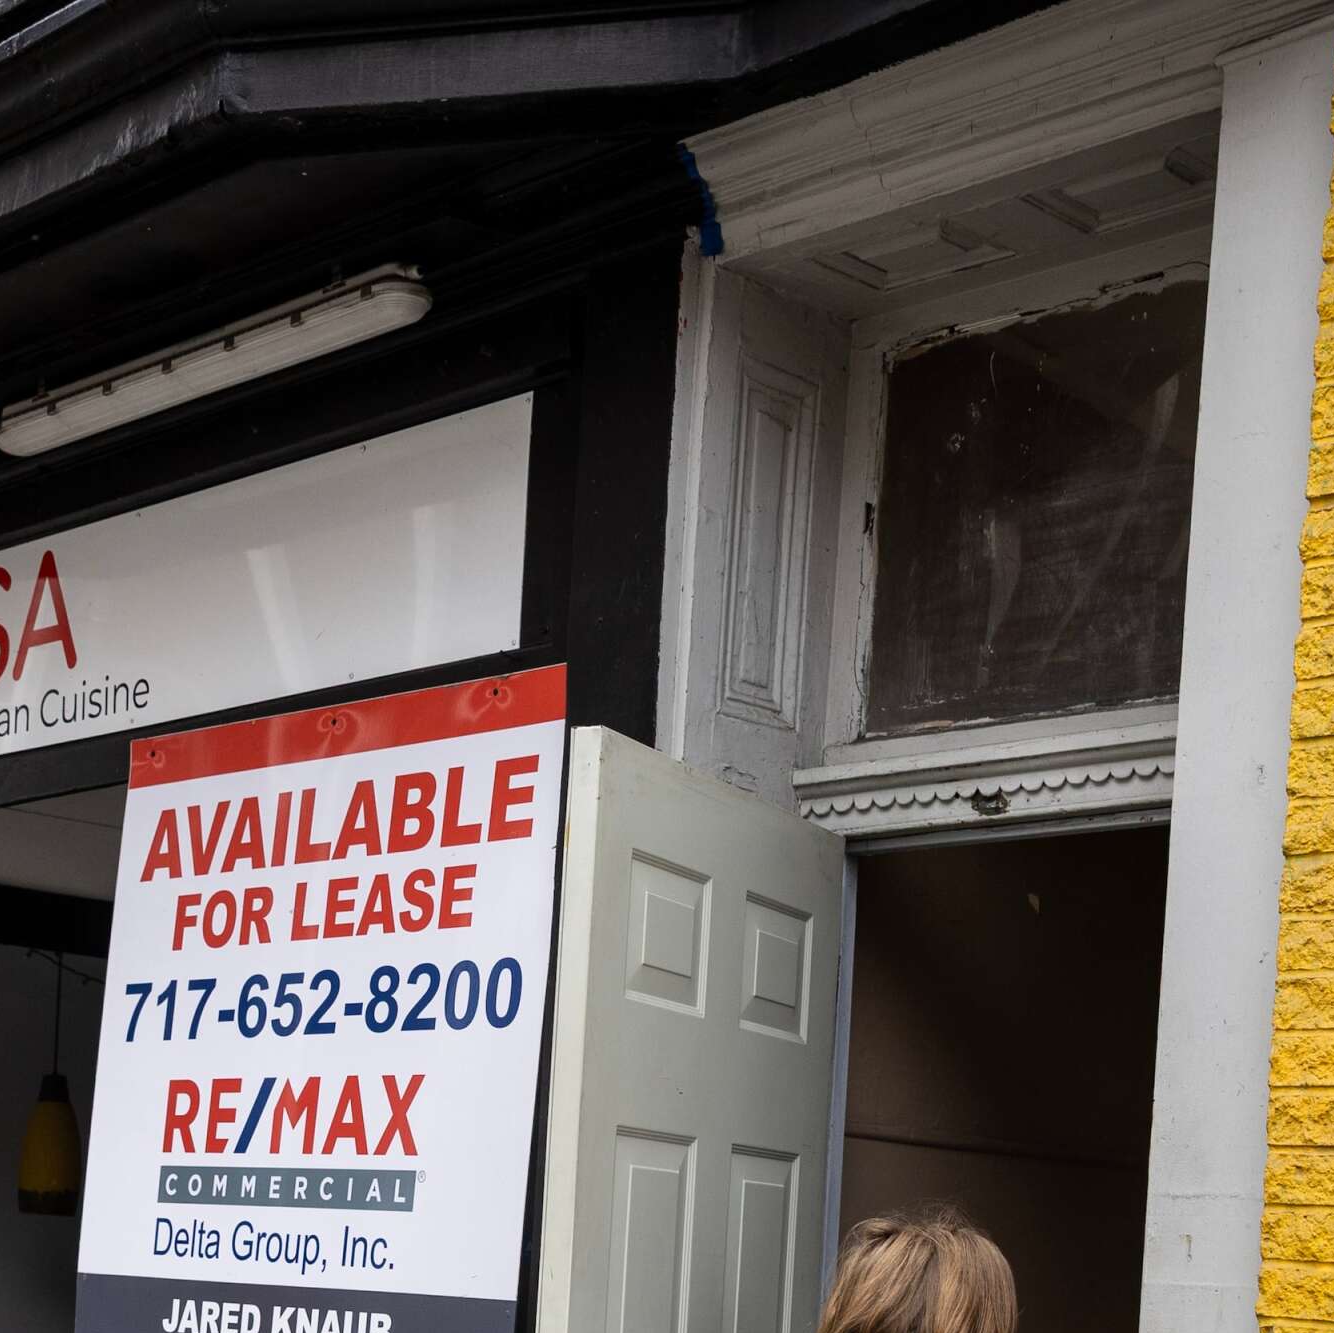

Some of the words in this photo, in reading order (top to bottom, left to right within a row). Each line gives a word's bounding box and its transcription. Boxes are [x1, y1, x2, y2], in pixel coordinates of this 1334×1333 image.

[39, 674, 150, 728] Cuisine
[140, 754, 540, 882] AVAILABLE
[172, 886, 275, 951] FOR
[290, 863, 478, 942] LEASE
[124, 956, 524, 1043] 717-652-8200
[162, 1073, 426, 1157] RE/MAX
[165, 1172, 408, 1204] COMMERCIAL
[153, 1217, 221, 1261] Delta
[230, 1219, 328, 1276] Group,
[341, 1225, 395, 1271] Inc.
